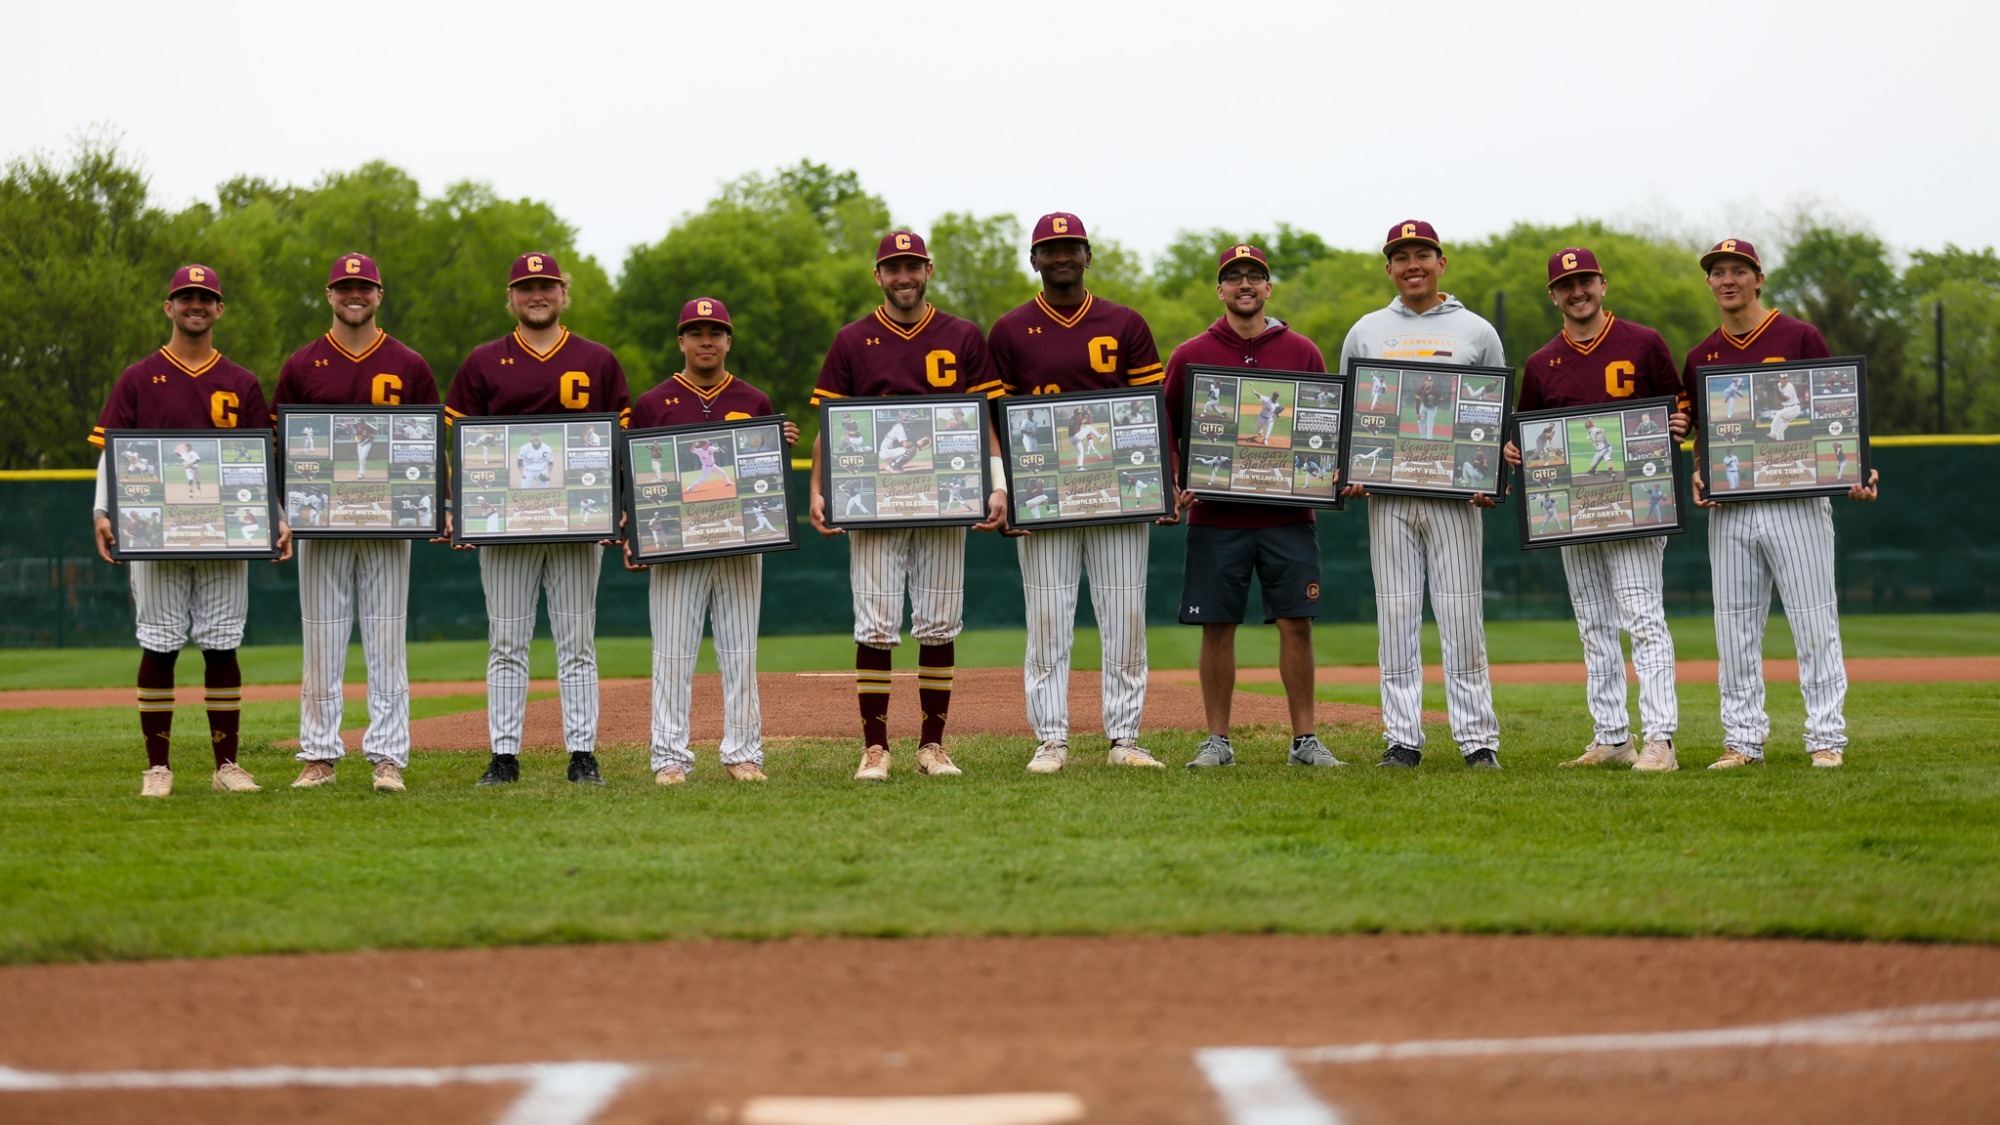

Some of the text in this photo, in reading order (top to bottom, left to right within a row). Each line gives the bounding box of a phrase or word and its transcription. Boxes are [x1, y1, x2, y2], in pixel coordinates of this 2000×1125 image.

[1052, 217, 1068, 234] C
[1401, 223, 1417, 238] C
[895, 234, 911, 250] C
[1720, 239, 1737, 252] C
[1234, 245, 1251, 258] C
[346, 258, 360, 274] C
[527, 256, 543, 272] C
[1562, 253, 1578, 270] C
[189, 268, 205, 282] C
[697, 301, 713, 316] C
[1088, 336, 1119, 373] C
[925, 349, 957, 388] C
[1604, 360, 1635, 398] C
[371, 373, 403, 406] C
[559, 370, 590, 409] C
[211, 390, 240, 428] C
[1401, 439, 1450, 452] Cougars
[1759, 441, 1809, 456] Cougars
[1238, 447, 1289, 462] Cougars
[1402, 450, 1448, 462] Baseball
[1762, 453, 1808, 467] Baseball
[1240, 458, 1286, 470] Baseball
[880, 475, 932, 488] Cougars
[1063, 472, 1112, 486] Cougars
[336, 484, 386, 497] Cougars
[512, 490, 562, 503] Cougars
[884, 485, 930, 498] Baseball
[1066, 482, 1112, 496] Baseball
[1575, 483, 1625, 500] Cougars
[338, 494, 385, 506] Baseball
[514, 500, 561, 512] Baseball
[1578, 493, 1624, 510] Baseball
[686, 502, 736, 516] Cougars
[690, 512, 735, 527] Baseball
[1306, 583, 1320, 598] C
